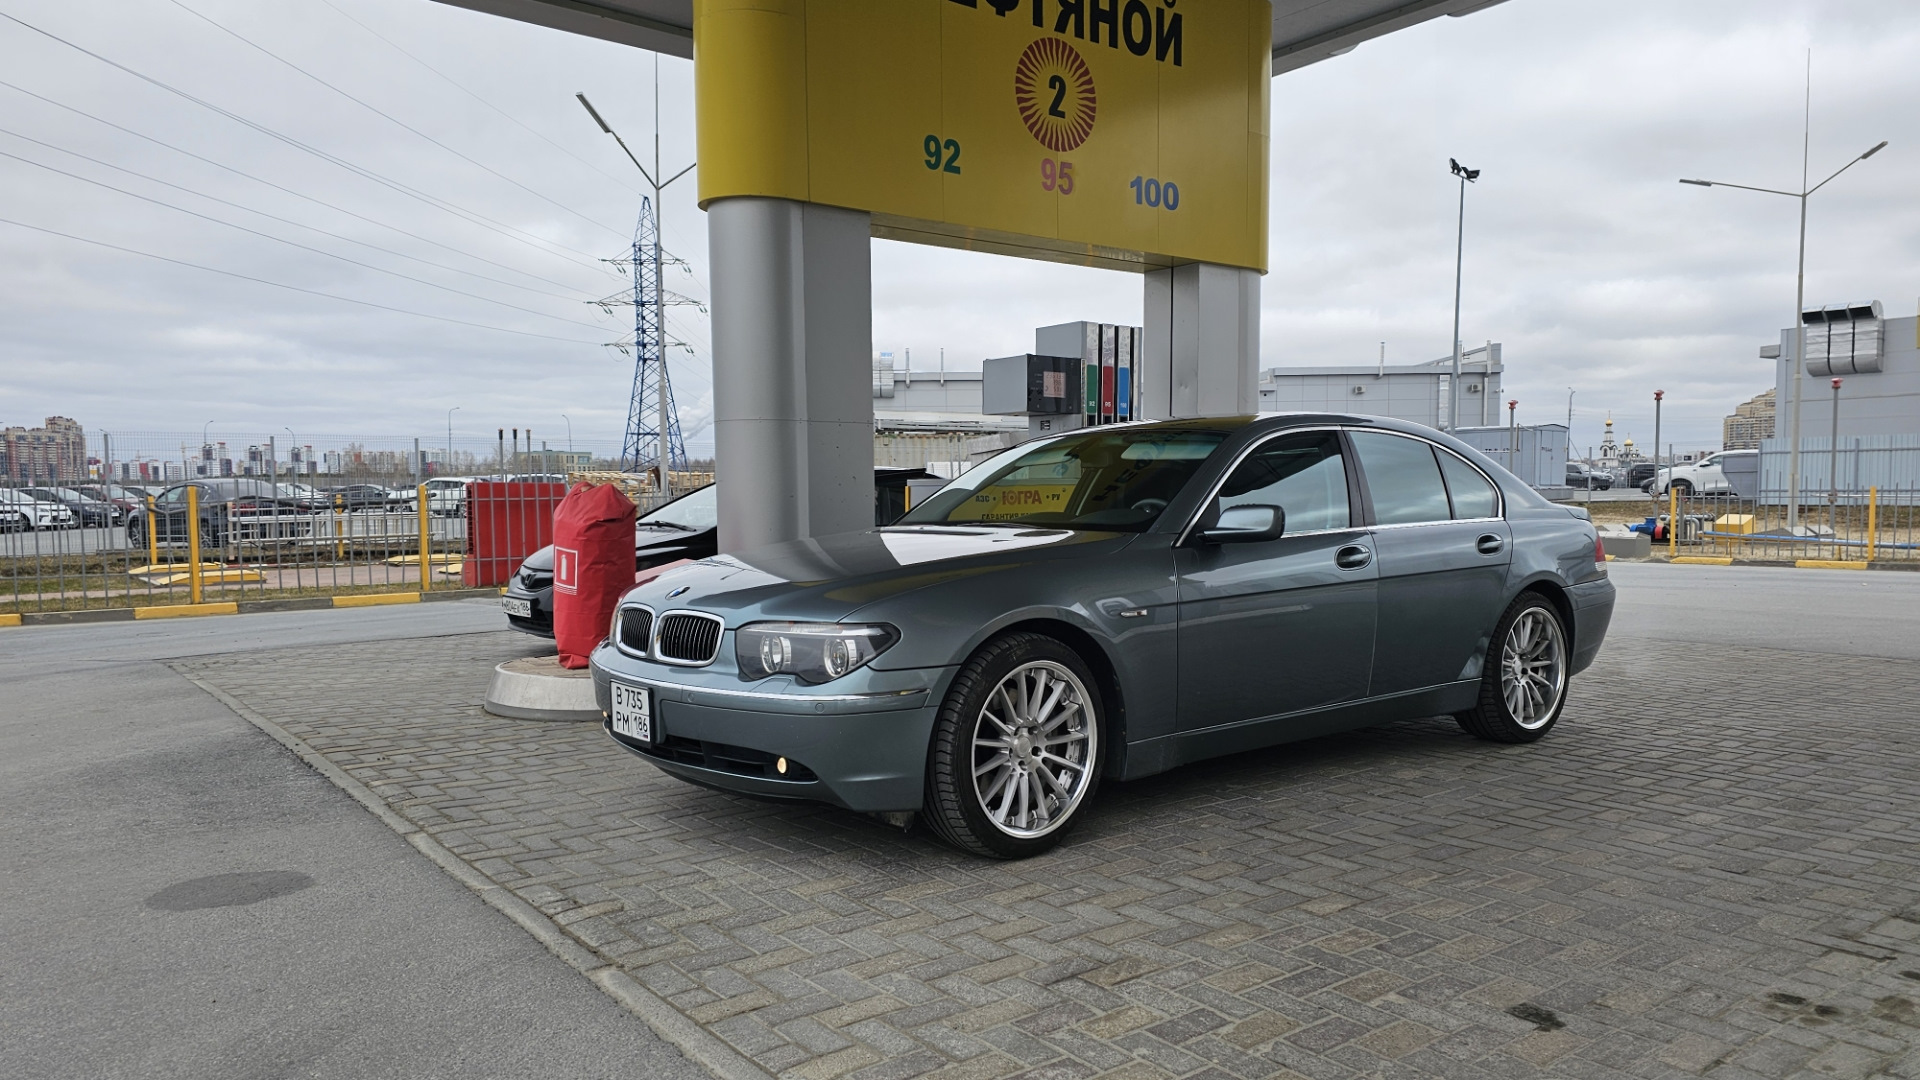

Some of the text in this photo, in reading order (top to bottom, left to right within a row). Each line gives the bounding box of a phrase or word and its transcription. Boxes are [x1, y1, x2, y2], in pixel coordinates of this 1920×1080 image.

[947, 0, 1182, 67] ЯНОЙ
[1048, 74, 1067, 119] 2
[924, 134, 961, 175] 92
[1041, 158, 1074, 195] 95
[1130, 175, 1180, 211] 100
[975, 495, 990, 503] АЗС
[1002, 490, 1042, 505] ЮГРА
[616, 710, 649, 733] РМ 186
